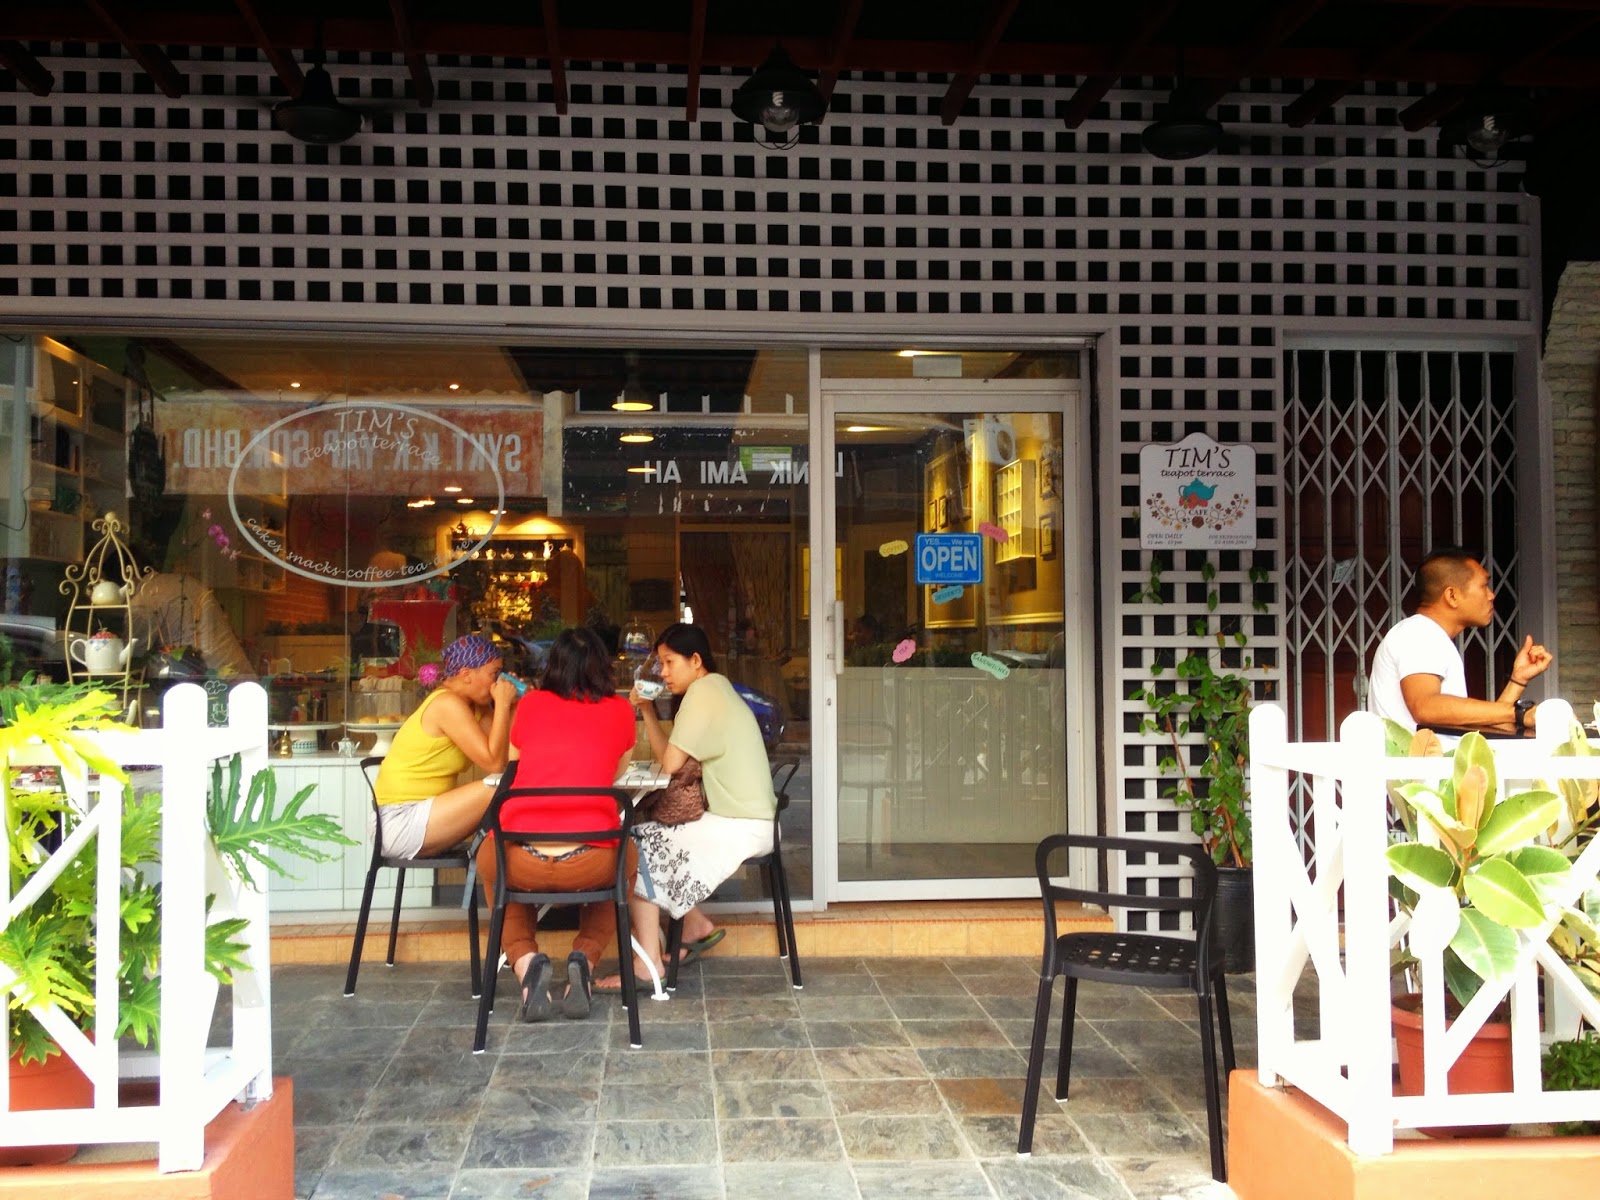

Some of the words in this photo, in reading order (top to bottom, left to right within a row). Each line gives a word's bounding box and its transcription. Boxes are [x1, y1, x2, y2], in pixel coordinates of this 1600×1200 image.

[334, 409, 418, 439] TIM'S
[304, 434, 369, 461] teapot
[372, 435, 443, 465] terrace
[1165, 446, 1231, 468] TIM'S
[1161, 469, 1194, 479] teapot
[1196, 469, 1236, 477] terrace
[921, 545, 977, 571] OPEN
